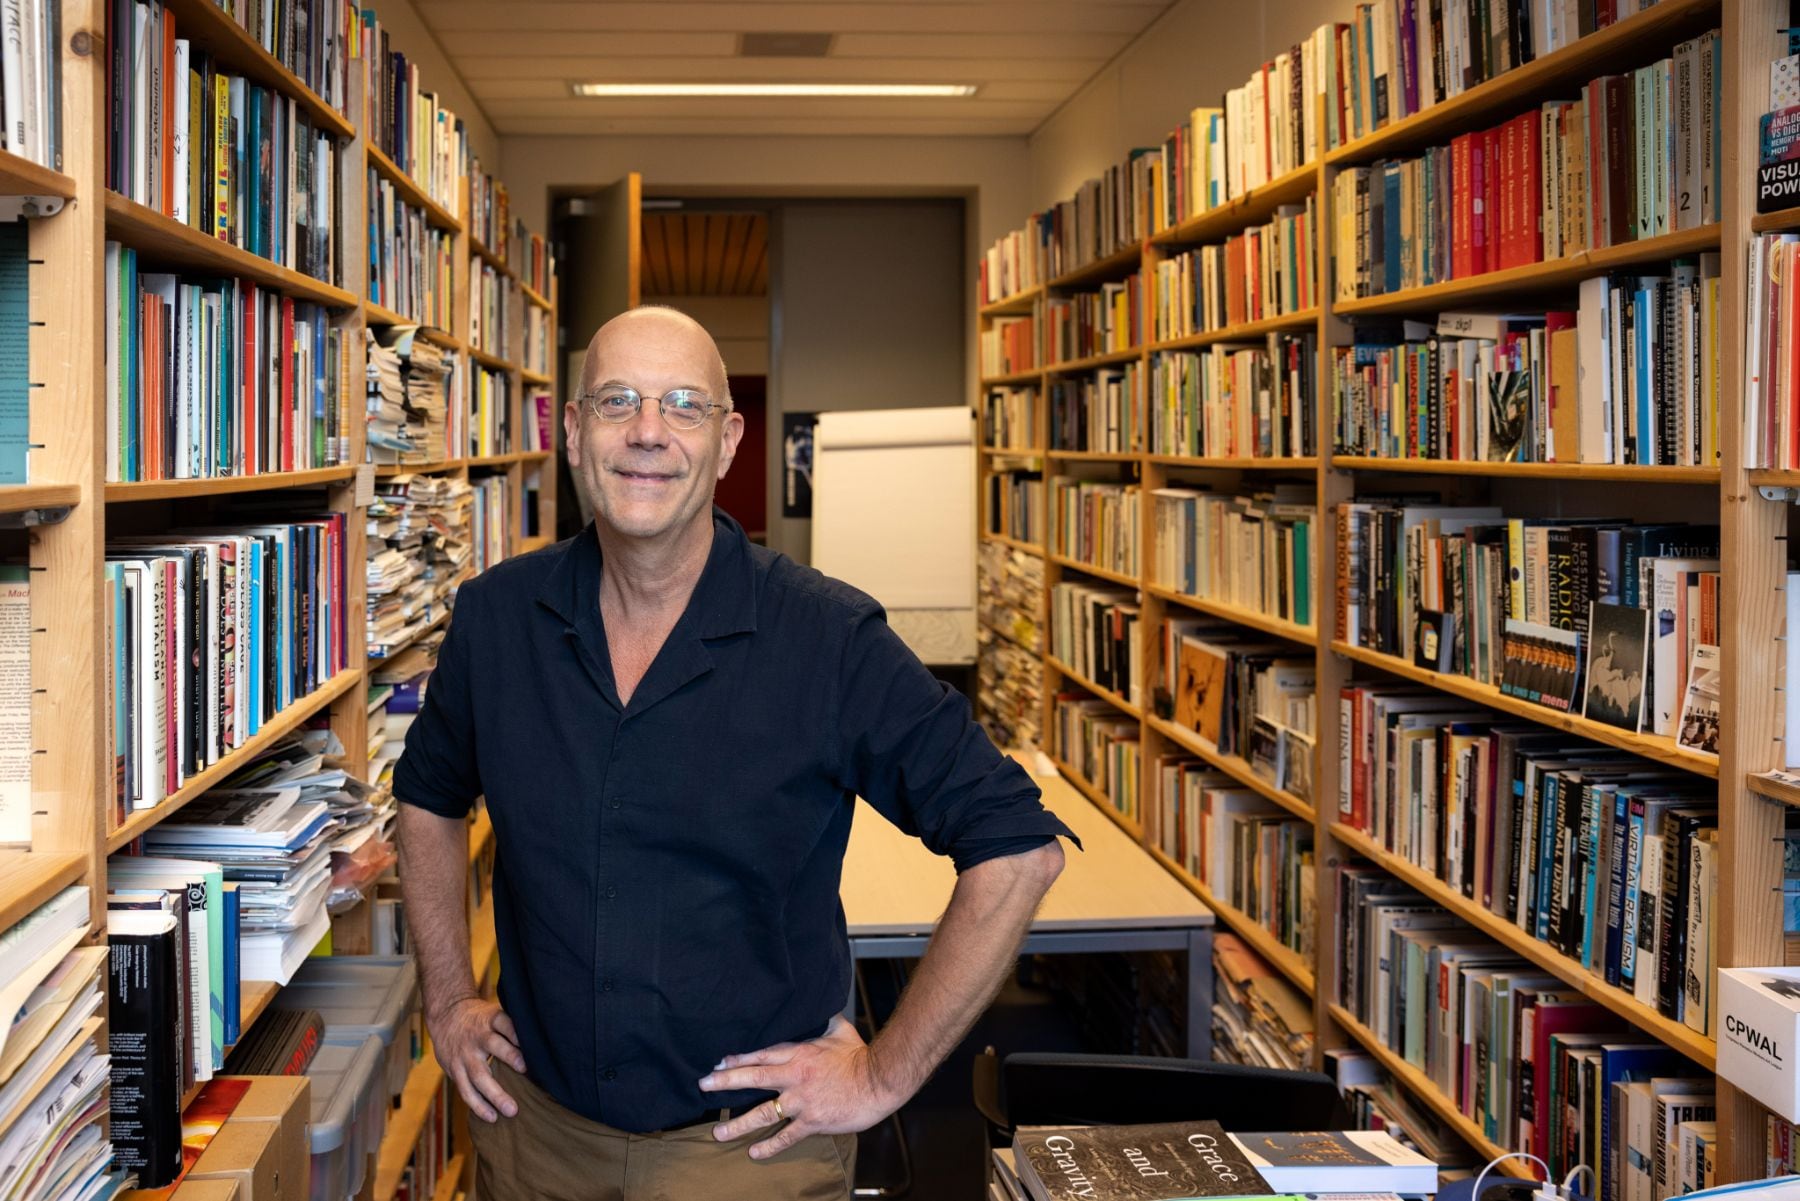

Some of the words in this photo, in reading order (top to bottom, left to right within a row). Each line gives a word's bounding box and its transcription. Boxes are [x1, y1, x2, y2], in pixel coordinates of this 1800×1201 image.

[218, 168, 228, 242] BRAIL
[1680, 191, 1690, 212] 2
[1703, 184, 1709, 204] 1
[1339, 514, 1348, 576] TOOLBOX
[1659, 543, 1710, 560] Living
[1549, 554, 1559, 627] ENLIGHTEN
[1571, 542, 1580, 613] NOTHING
[1580, 577, 1588, 615] THAN
[1338, 586, 1347, 639] UTOPIA
[1540, 693, 1569, 710] mens
[1555, 782, 1567, 858] TERMINAL
[1626, 824, 1639, 888] VIRTUAL
[1663, 812, 1680, 897] ROTTEN
[1550, 858, 1562, 934] IDENTITY
[1622, 899, 1634, 969] REALISM
[1664, 920, 1673, 945] John
[1661, 950, 1671, 983] Lydon
[1726, 1014, 1783, 1062] CPWAL
[1045, 1135, 1098, 1198] Gravity
[1122, 1147, 1169, 1178] and
[1188, 1134, 1238, 1182] Grace
[1656, 1100, 1666, 1186] TRANSYLVANIA
